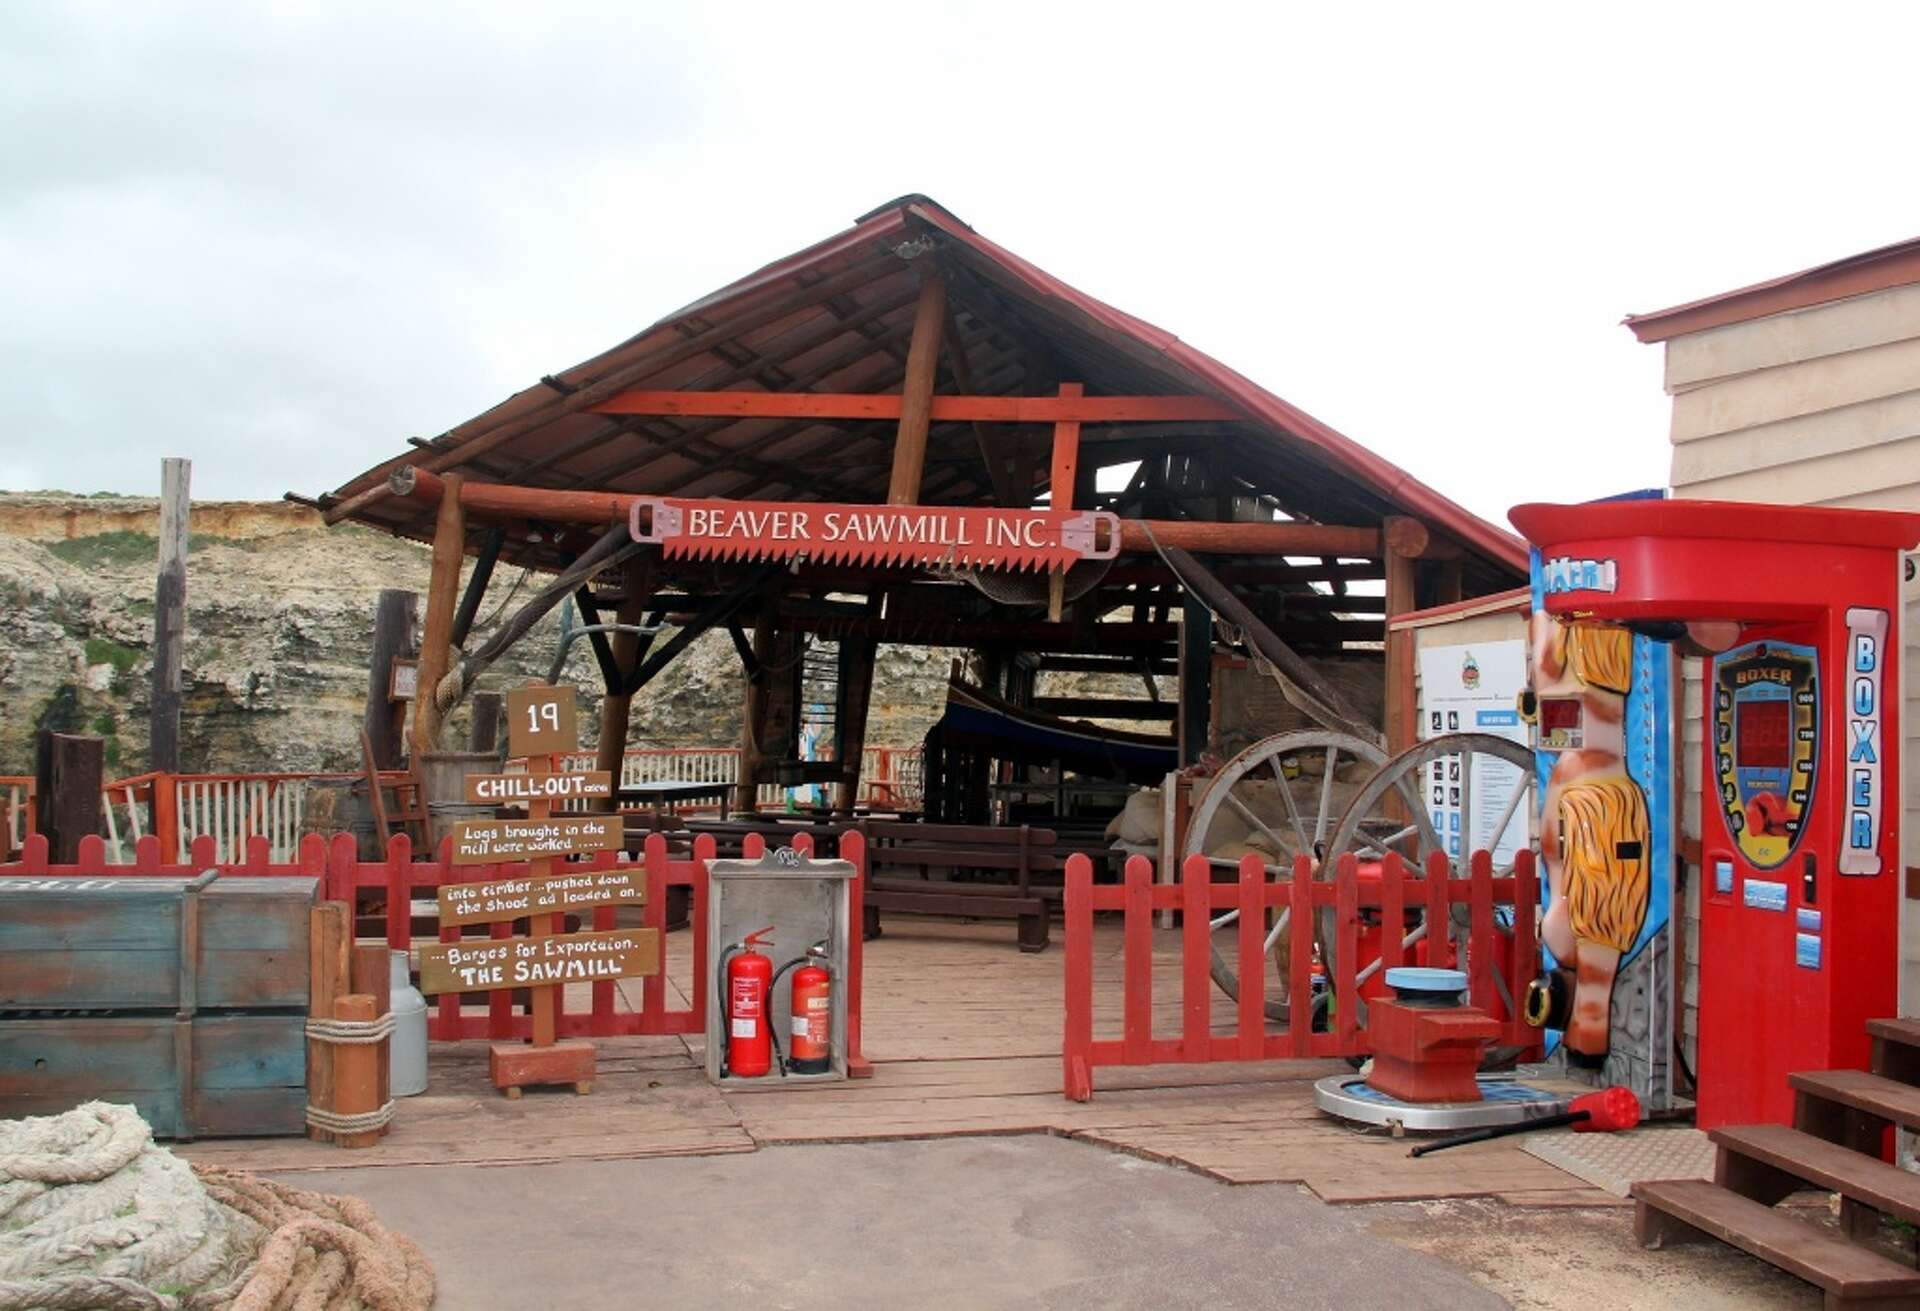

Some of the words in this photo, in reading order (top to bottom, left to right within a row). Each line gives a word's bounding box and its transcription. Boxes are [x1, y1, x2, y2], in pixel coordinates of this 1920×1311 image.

[688, 508, 811, 541] BEAVER
[822, 512, 974, 546] SAWMILL
[985, 517, 1058, 549] INC.
[1736, 667, 1792, 684] BOXER
[527, 702, 559, 733] 19
[1850, 635, 1877, 849] BOXER
[476, 776, 586, 797] CHILL-OUT
[464, 826, 498, 842] Logs
[505, 823, 560, 841] brought
[565, 823, 579, 834] in
[582, 821, 605, 834] the
[460, 840, 489, 855] mill
[493, 842, 523, 853] were
[527, 837, 573, 851] worked
[447, 888, 477, 901] into
[597, 874, 629, 886] down
[456, 901, 481, 915] the
[563, 890, 612, 903] loaded
[514, 942, 538, 957] for
